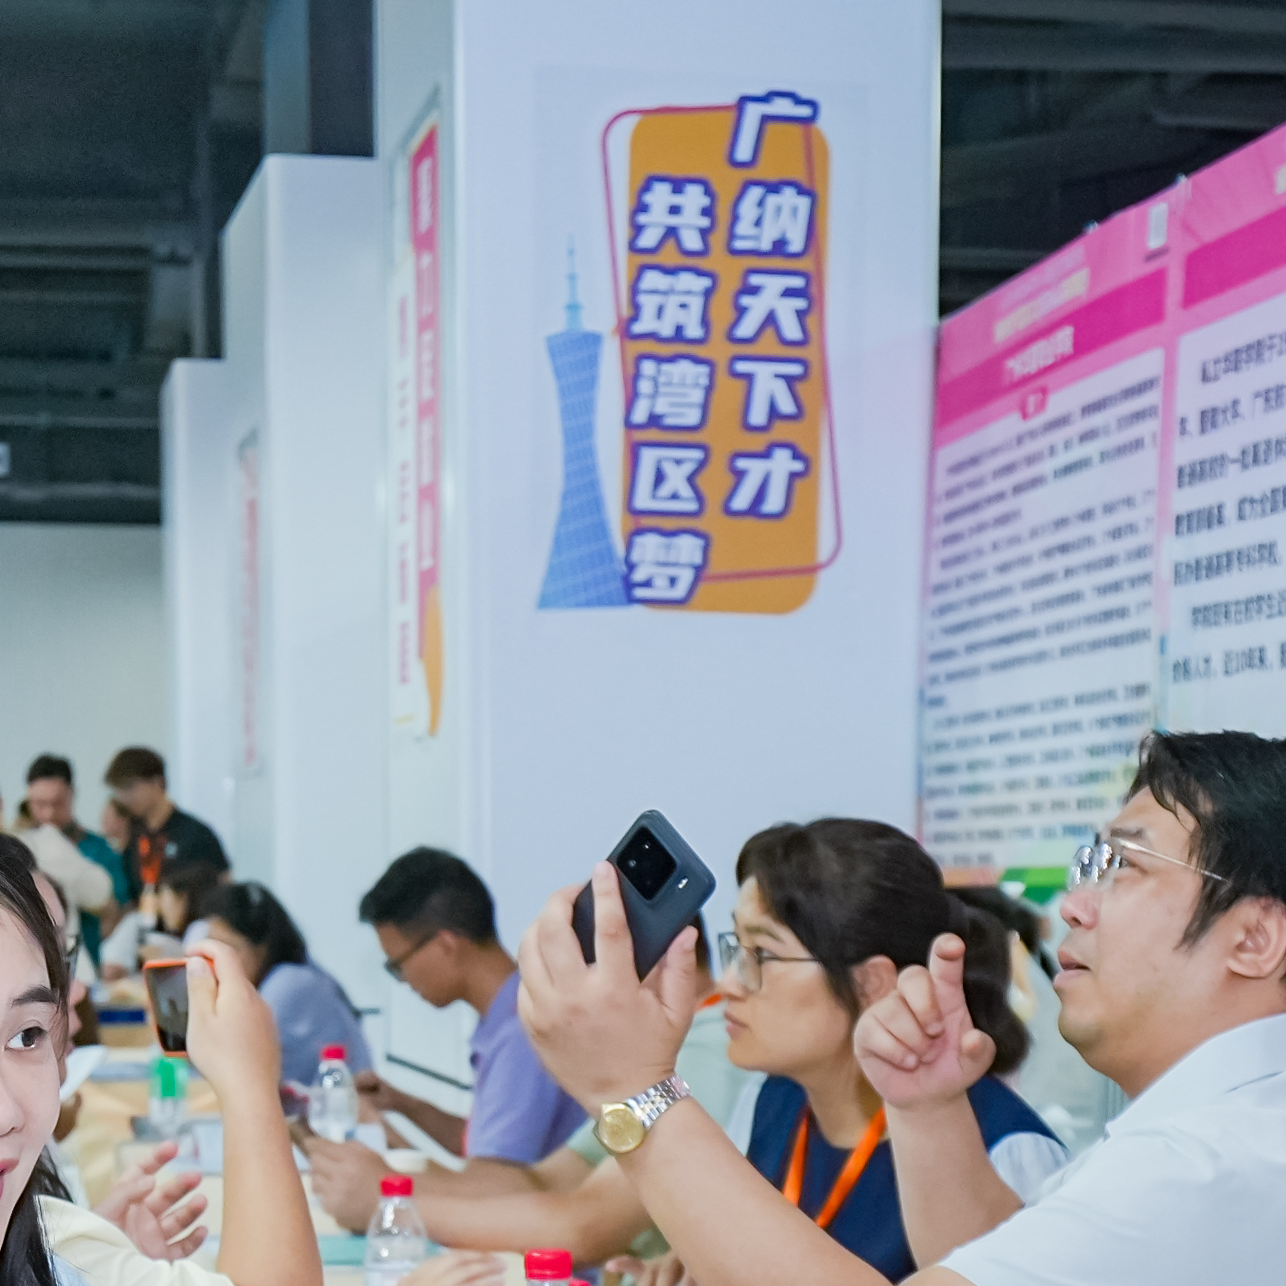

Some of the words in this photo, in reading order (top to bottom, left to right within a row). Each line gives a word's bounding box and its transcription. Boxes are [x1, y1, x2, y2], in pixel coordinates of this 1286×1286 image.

[624, 178, 715, 604] 共筑湾区梦
[727, 92, 817, 517] 广纳天下才
